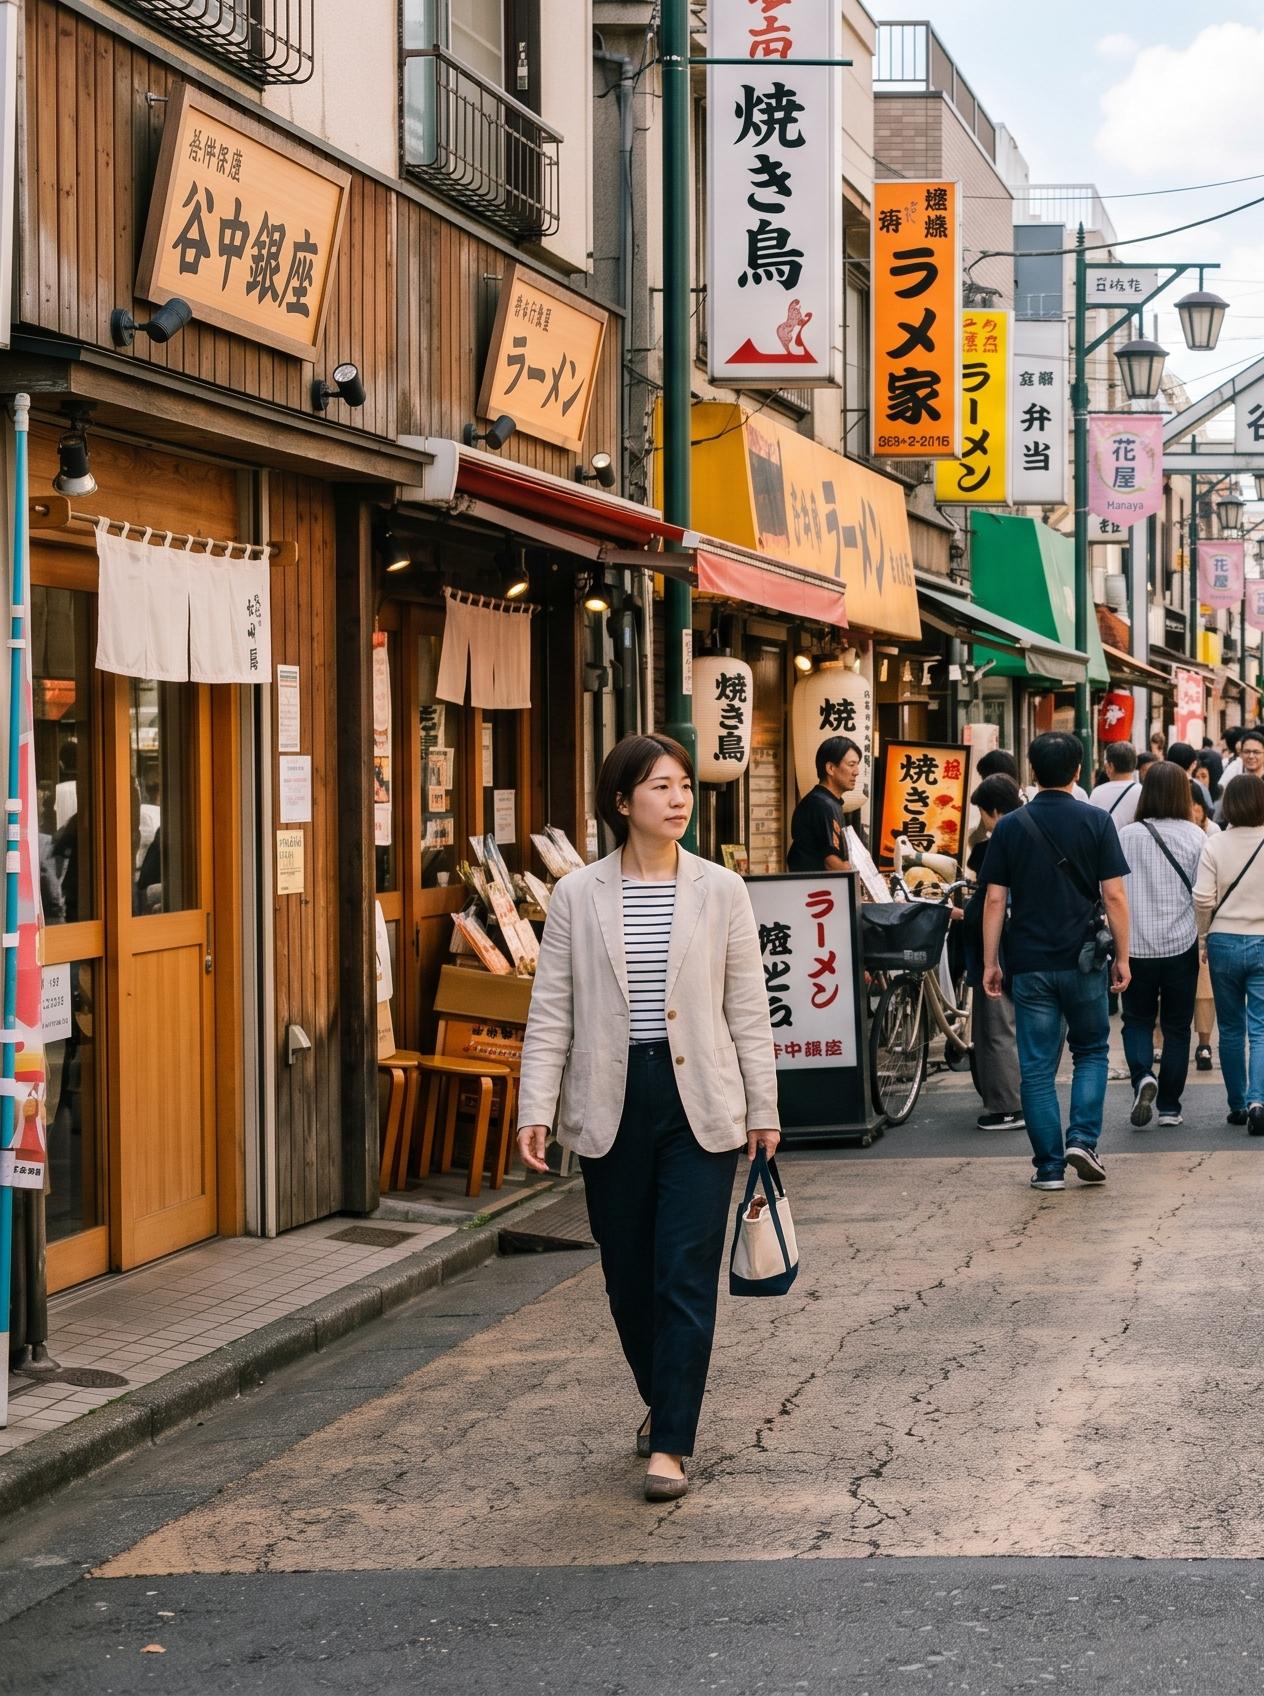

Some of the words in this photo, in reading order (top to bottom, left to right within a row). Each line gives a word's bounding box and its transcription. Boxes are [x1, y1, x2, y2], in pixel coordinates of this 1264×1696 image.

[733, 81, 807, 291] 焼き鳥
[172, 180, 319, 318] 谷中銀座
[503, 336, 585, 417] ラーメン
[886, 247, 942, 425] ラメ家
[957, 362, 991, 493] ラーメン
[1020, 402, 1052, 471] 弁当
[1112, 438, 1136, 489] 花屋
[1107, 501, 1144, 512] Hanaya
[713, 672, 747, 763] 焼き鳥
[891, 753, 939, 853] 焼き鳥
[805, 890, 839, 1009] ラーメン
